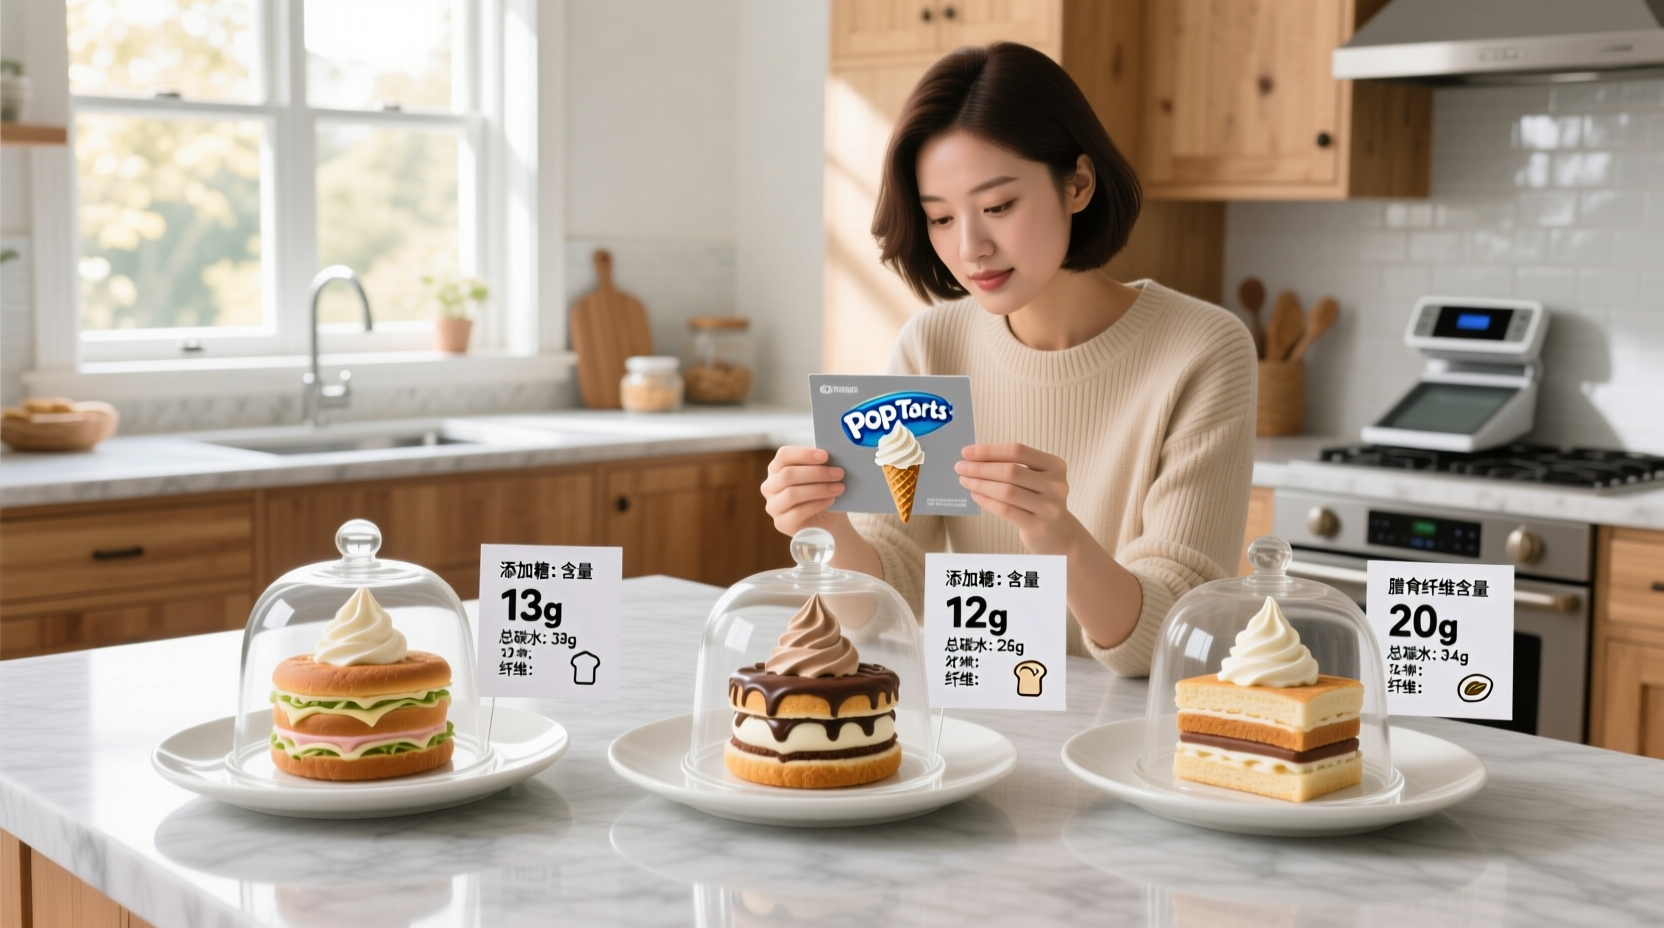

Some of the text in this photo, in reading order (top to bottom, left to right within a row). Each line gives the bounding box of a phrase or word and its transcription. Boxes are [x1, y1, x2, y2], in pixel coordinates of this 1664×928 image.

[501, 588, 562, 629] 13g
[946, 595, 1008, 637] 12g
[1388, 603, 1458, 647] 20g
[997, 639, 1024, 657] 26g
